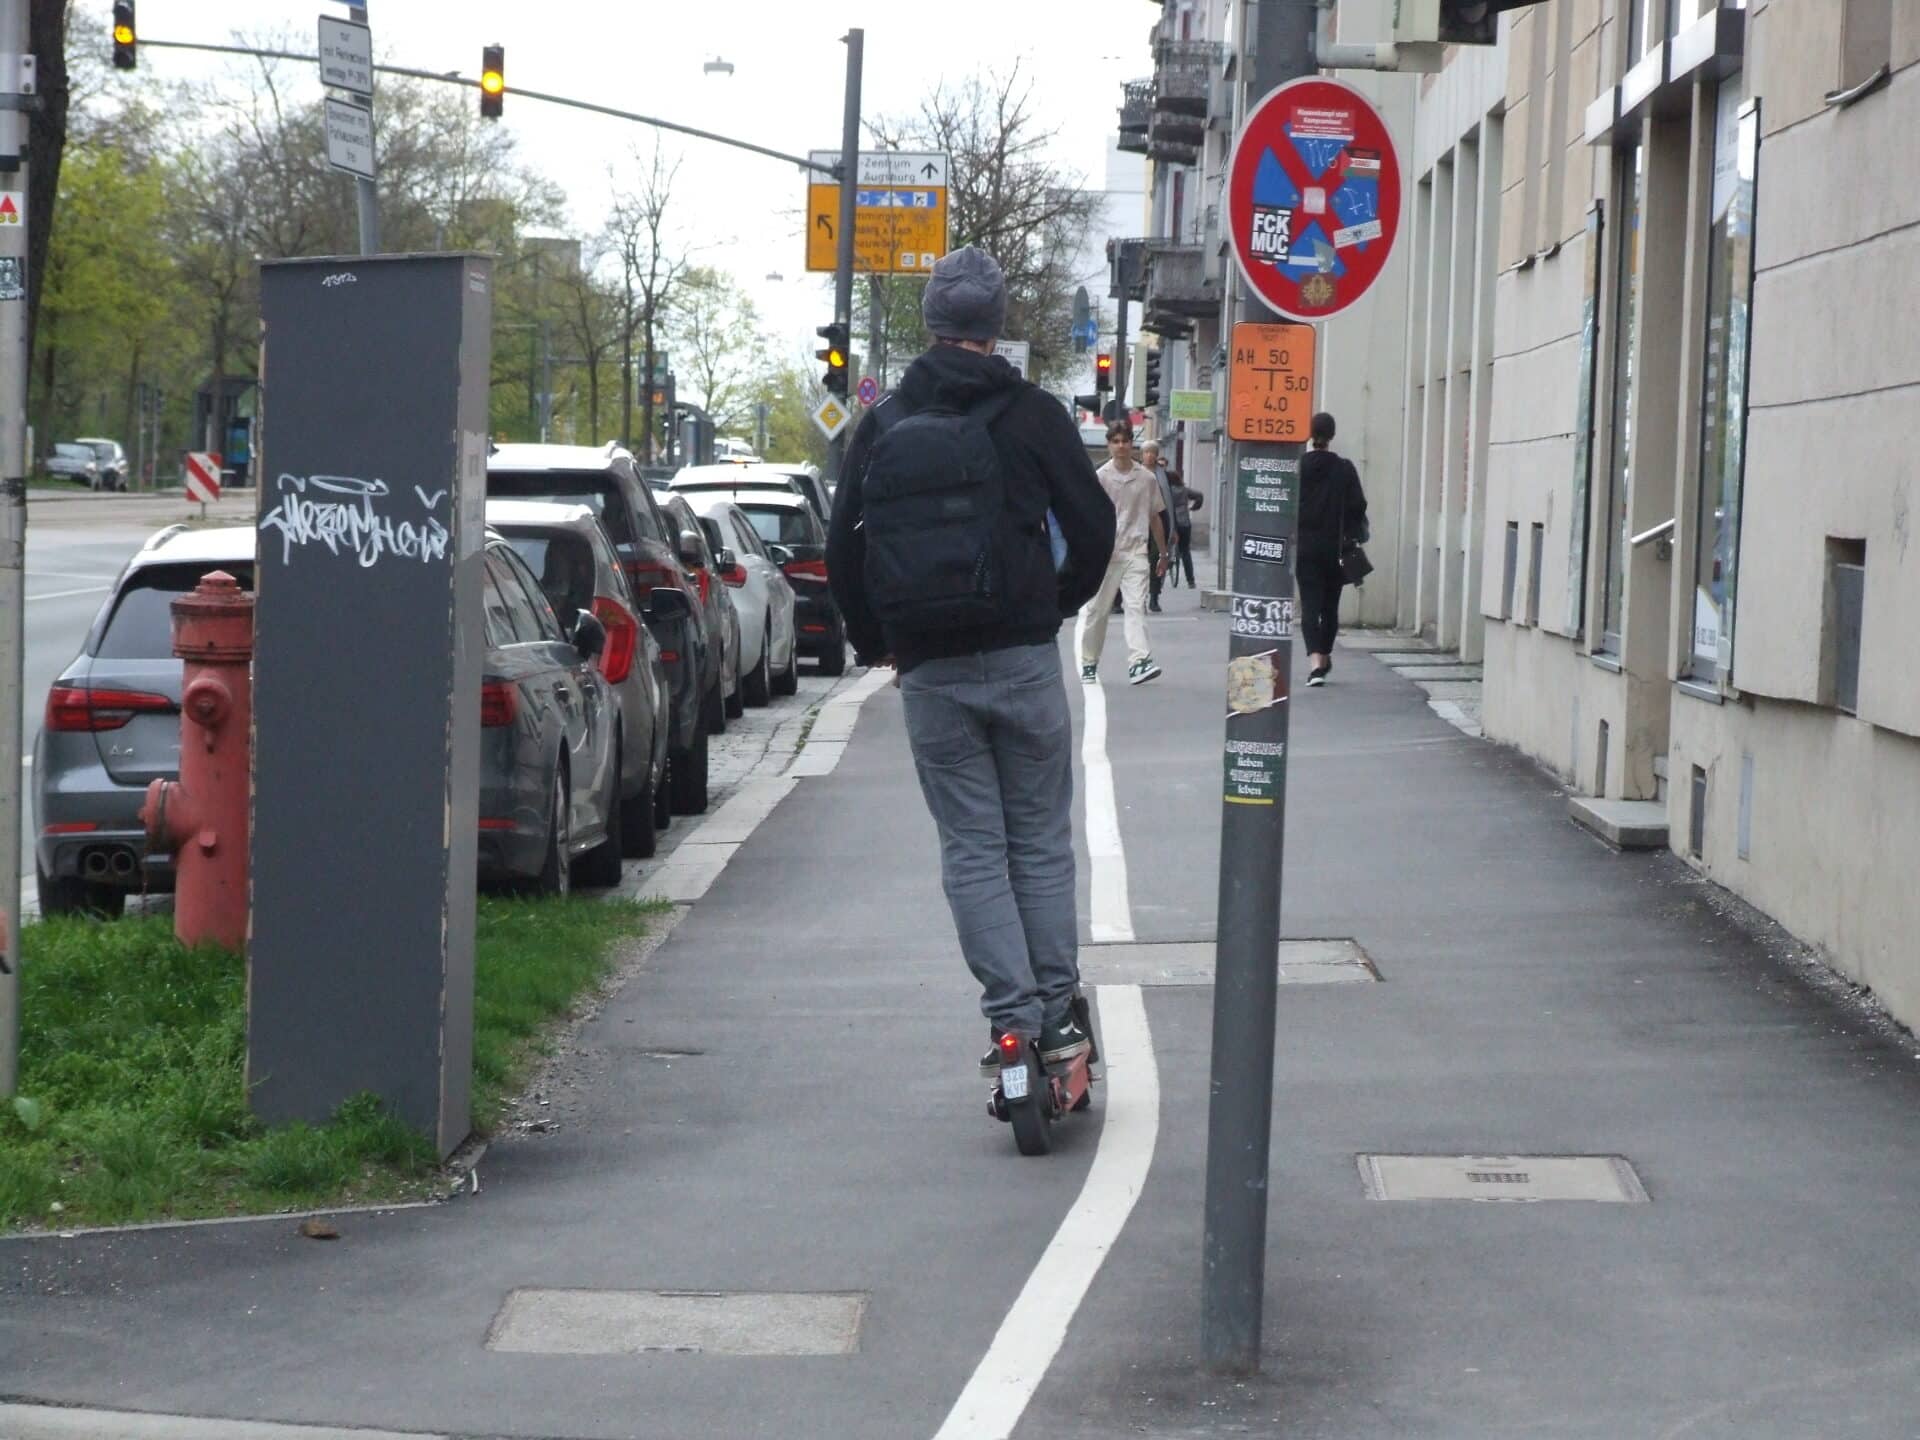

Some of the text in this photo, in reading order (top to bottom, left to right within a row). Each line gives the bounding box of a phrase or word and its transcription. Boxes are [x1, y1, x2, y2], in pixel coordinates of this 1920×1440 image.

[1253, 212, 1291, 235] FCK
[1251, 232, 1289, 254] MUC
[1235, 348, 1289, 365] AH 50
[1244, 418, 1295, 435] E1525
